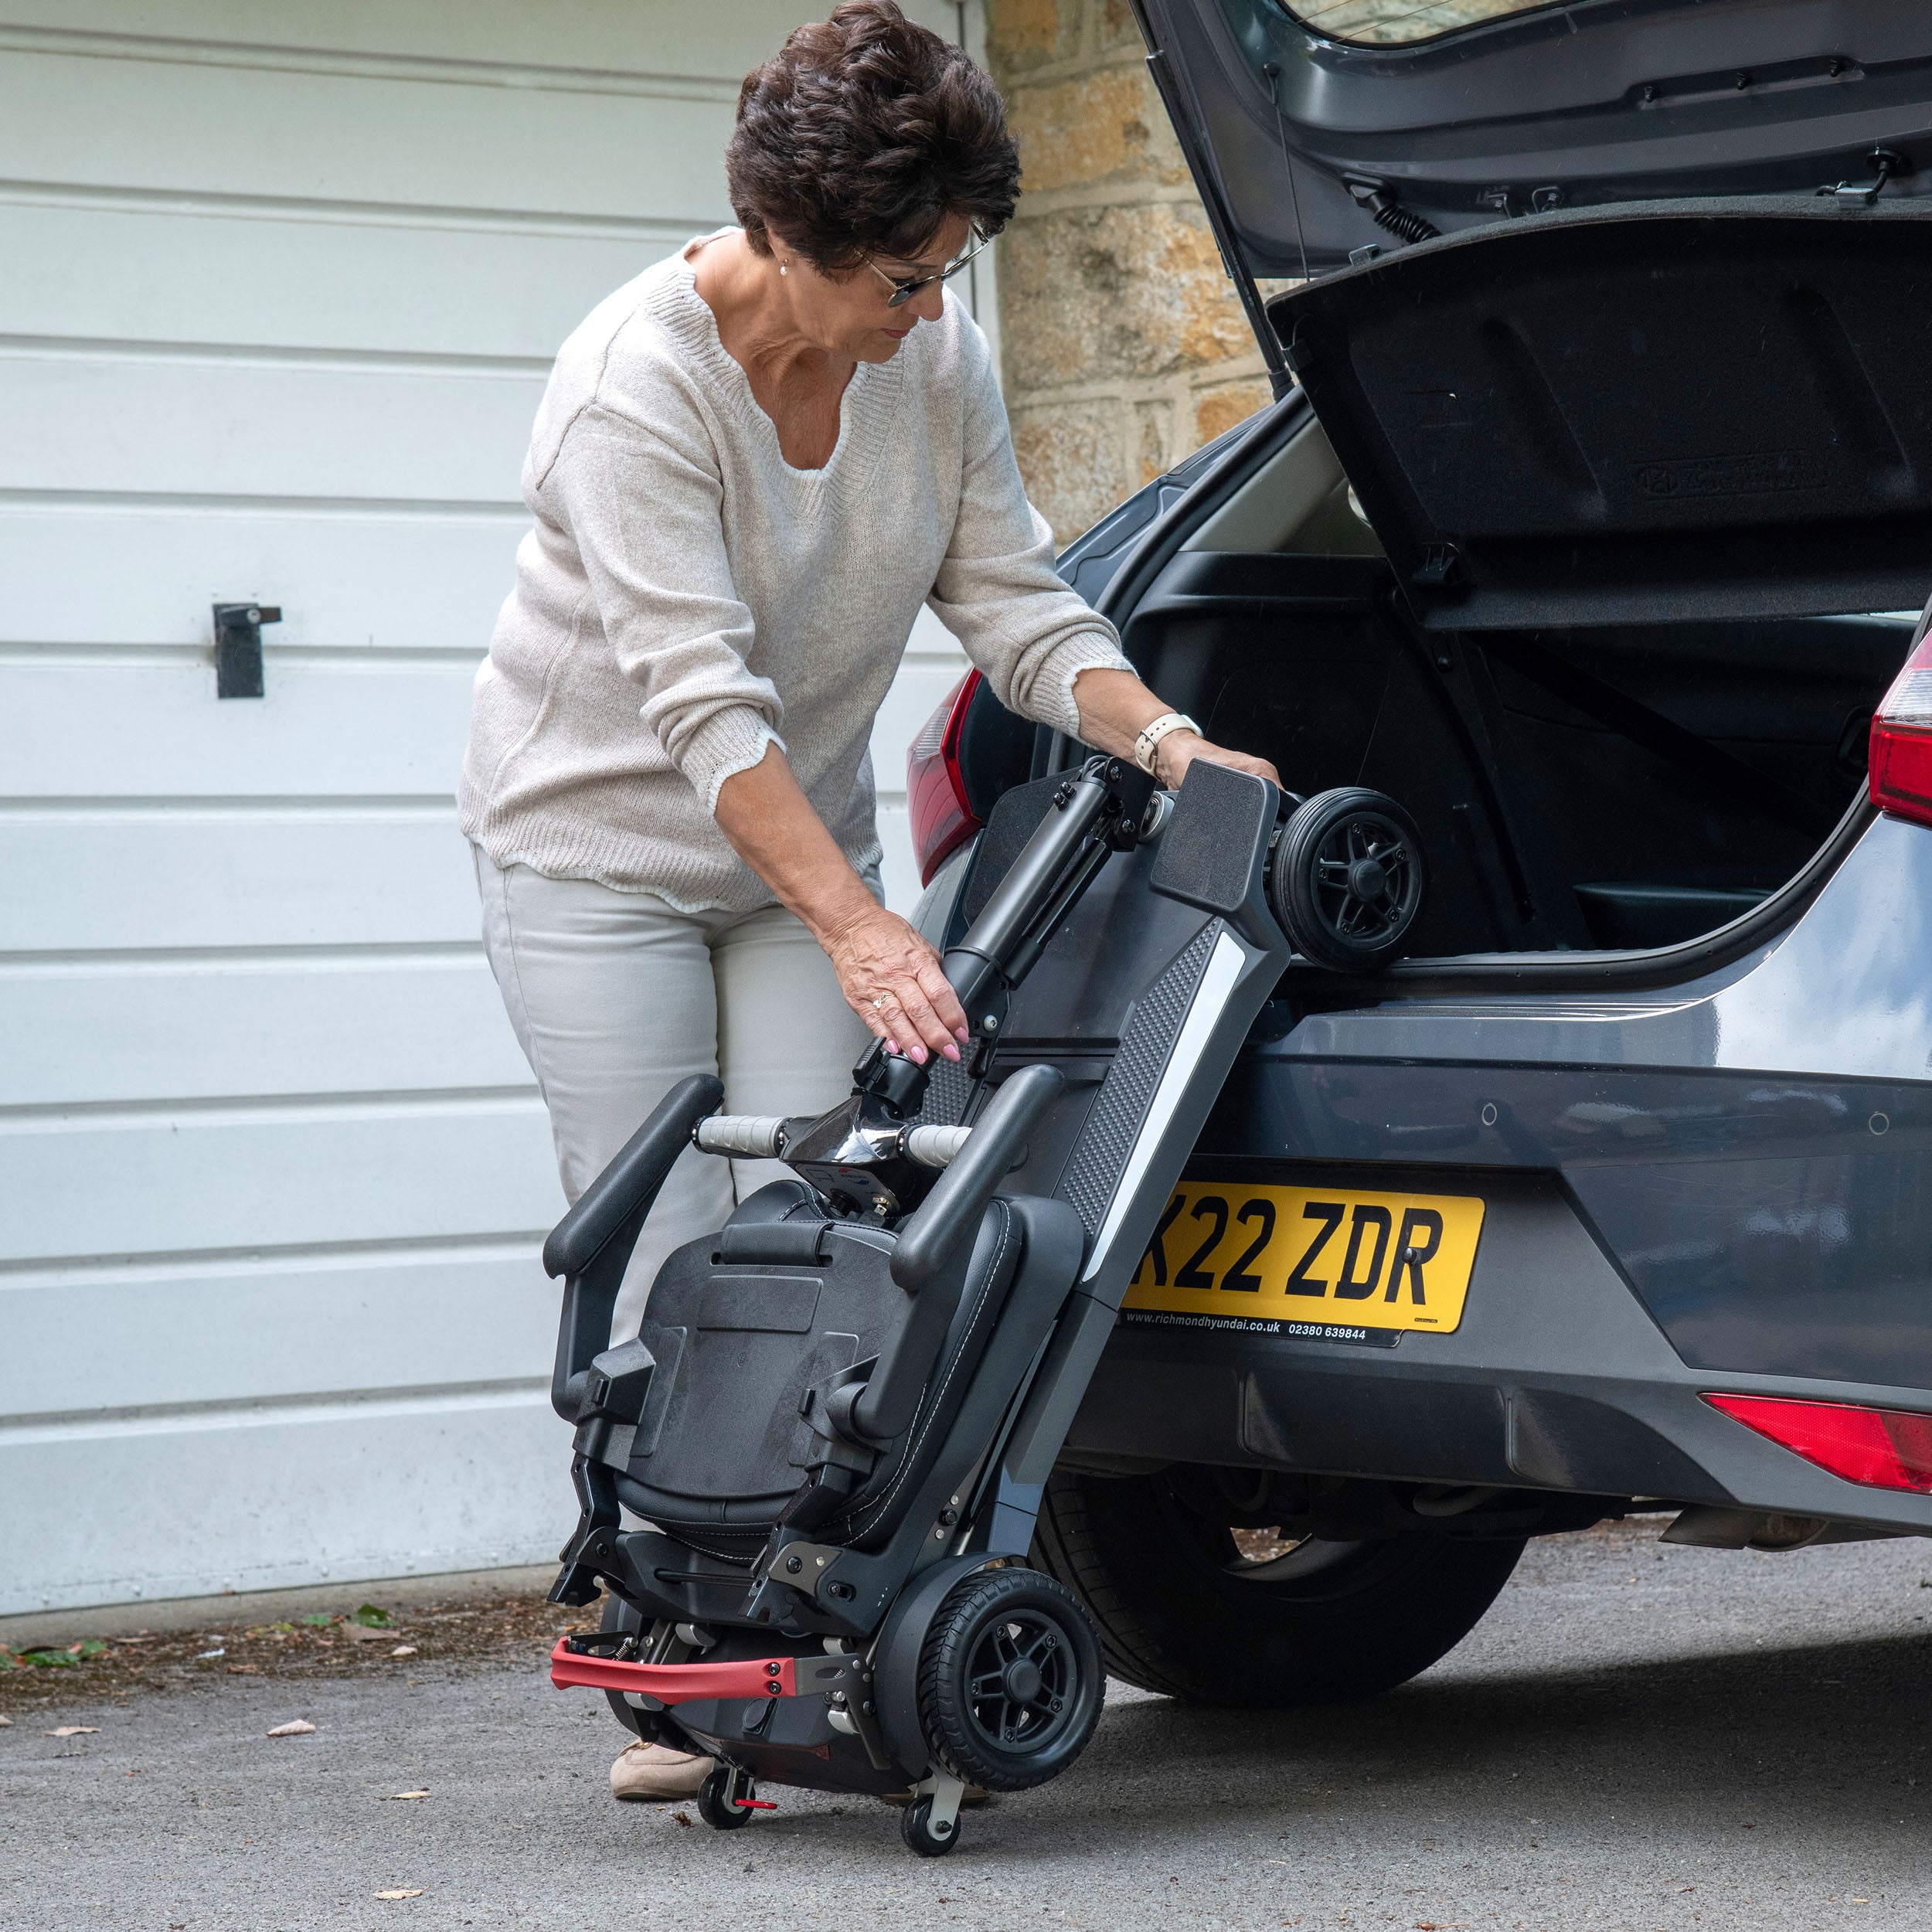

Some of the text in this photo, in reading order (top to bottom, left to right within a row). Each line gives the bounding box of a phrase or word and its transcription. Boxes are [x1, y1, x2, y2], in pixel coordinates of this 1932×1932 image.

[1284, 1201, 1444, 1305] ZDR
[1126, 1312, 1366, 1340] www.richmondhyundai.co.uk 02380 639844
